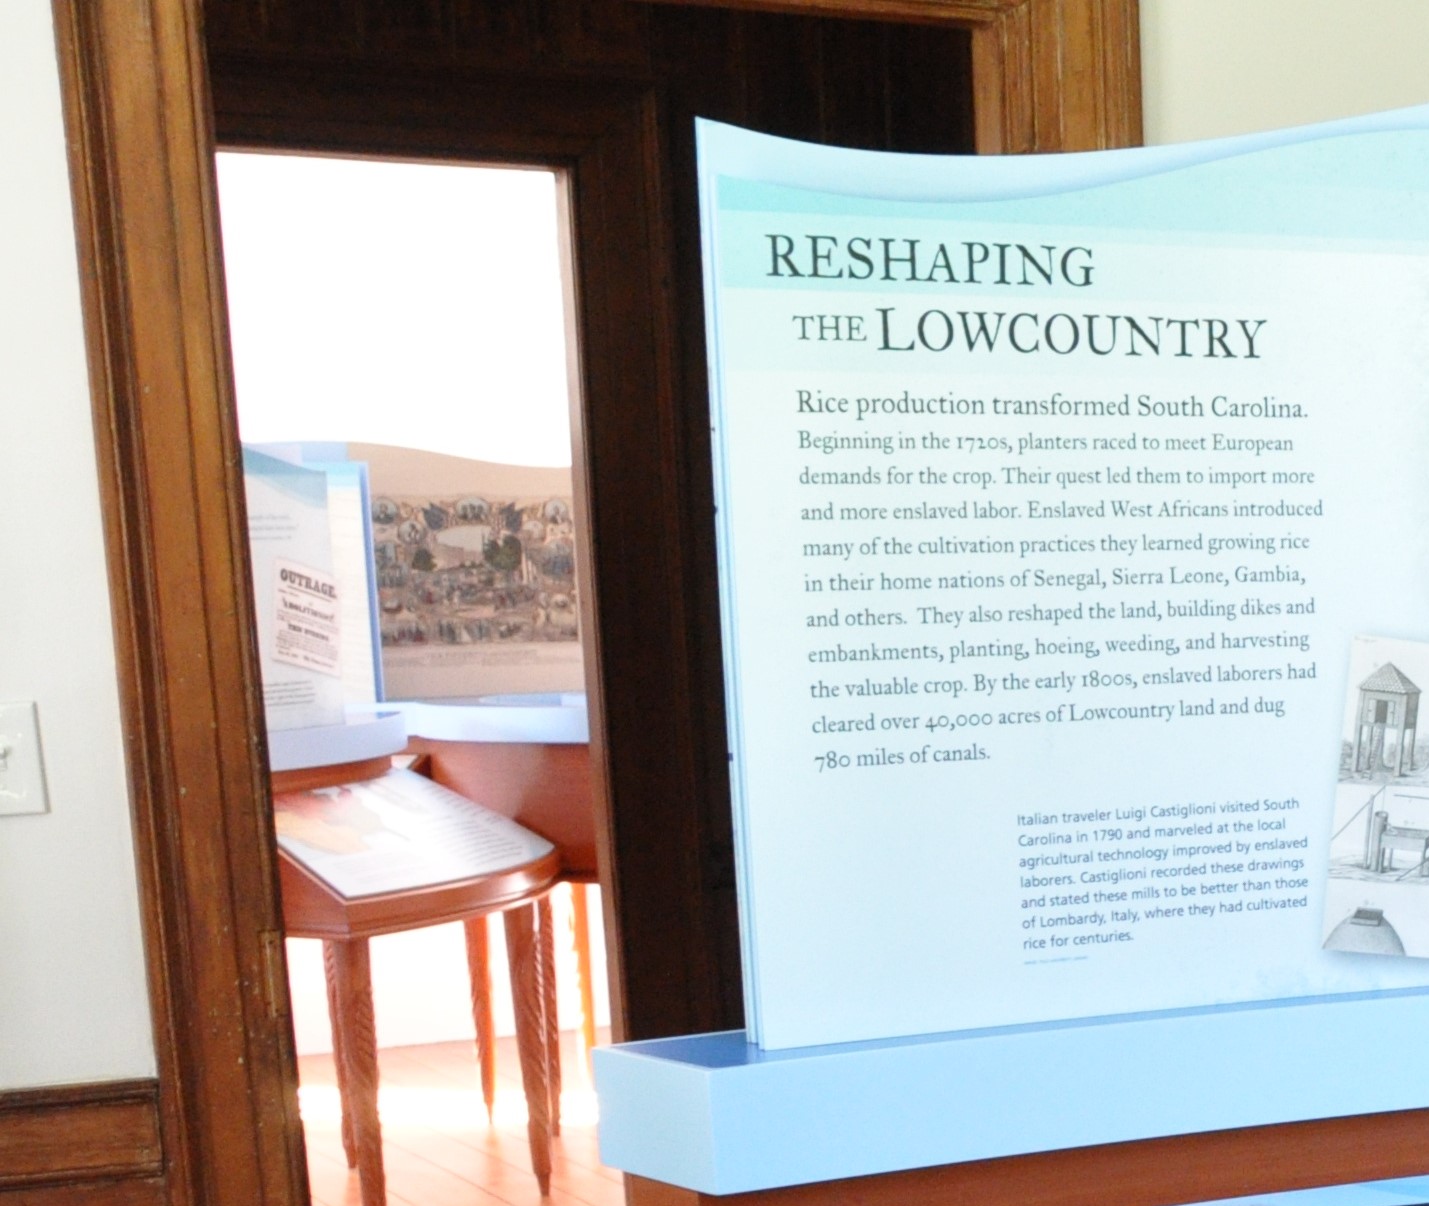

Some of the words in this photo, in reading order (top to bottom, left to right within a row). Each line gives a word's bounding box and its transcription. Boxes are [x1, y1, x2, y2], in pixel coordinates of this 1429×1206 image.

[766, 235, 1094, 287] RESHAPING
[793, 316, 867, 341] THE
[876, 308, 1267, 358] LOWCOUNTRY
[797, 390, 849, 413] Rice
[856, 391, 985, 421] production
[993, 393, 1130, 416] transformed
[1138, 395, 1204, 417] South
[1212, 396, 1308, 418] Carolina.
[798, 430, 894, 455] Beginning
[899, 432, 916, 449] in
[922, 432, 950, 449] the
[957, 437, 1013, 454] 1720s,
[1018, 432, 1087, 455] planters
[1093, 432, 1137, 450] raced
[1142, 437, 1160, 450] to
[1166, 438, 1206, 450] meet
[1212, 434, 1293, 456] European
[815, 751, 851, 773] 780
[857, 748, 905, 767] miles
[910, 745, 931, 763] of
[933, 743, 990, 762] canals.
[1018, 813, 1058, 826] Italian
[1062, 809, 1112, 823] traveler
[1116, 807, 1146, 822] Luigi
[1150, 802, 1216, 819] Castiglioni
[1220, 800, 1260, 813] visited
[1264, 798, 1300, 811] South
[1024, 938, 1046, 950] rice
[1050, 935, 1069, 947] for
[1073, 931, 1134, 946] centuries.
